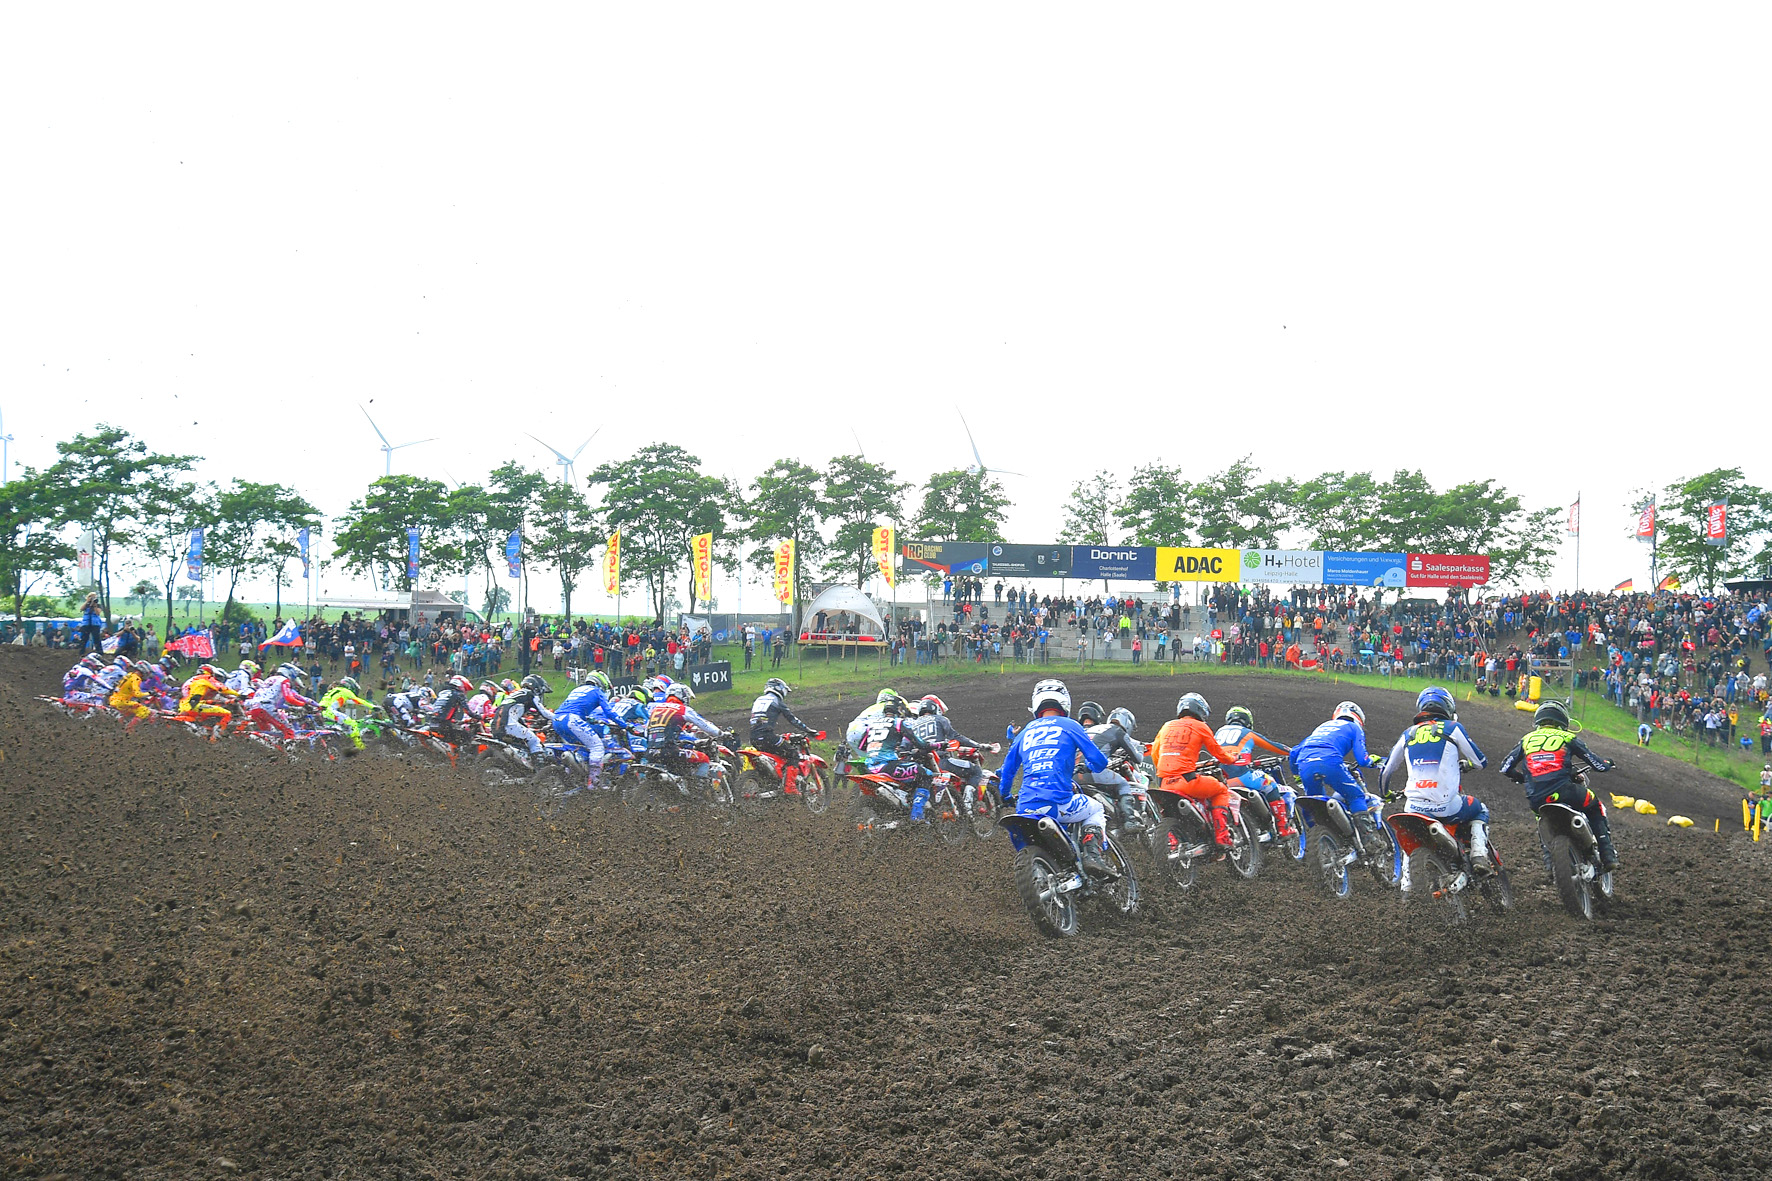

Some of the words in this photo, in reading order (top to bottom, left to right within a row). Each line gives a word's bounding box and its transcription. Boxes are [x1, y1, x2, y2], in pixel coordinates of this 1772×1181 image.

[908, 545, 922, 558] RC
[1090, 549, 1138, 561] Dorint
[1173, 556, 1222, 574] ADAC
[1327, 555, 1368, 563] Versicherungen
[1425, 564, 1484, 573] Saalesparkasse
[704, 670, 728, 684] FOX
[1022, 726, 1063, 751] 822
[1164, 727, 1192, 746] 48
[1214, 729, 1242, 745] 90
[1028, 748, 1060, 760] UFO
[1415, 779, 1438, 788] KTM
